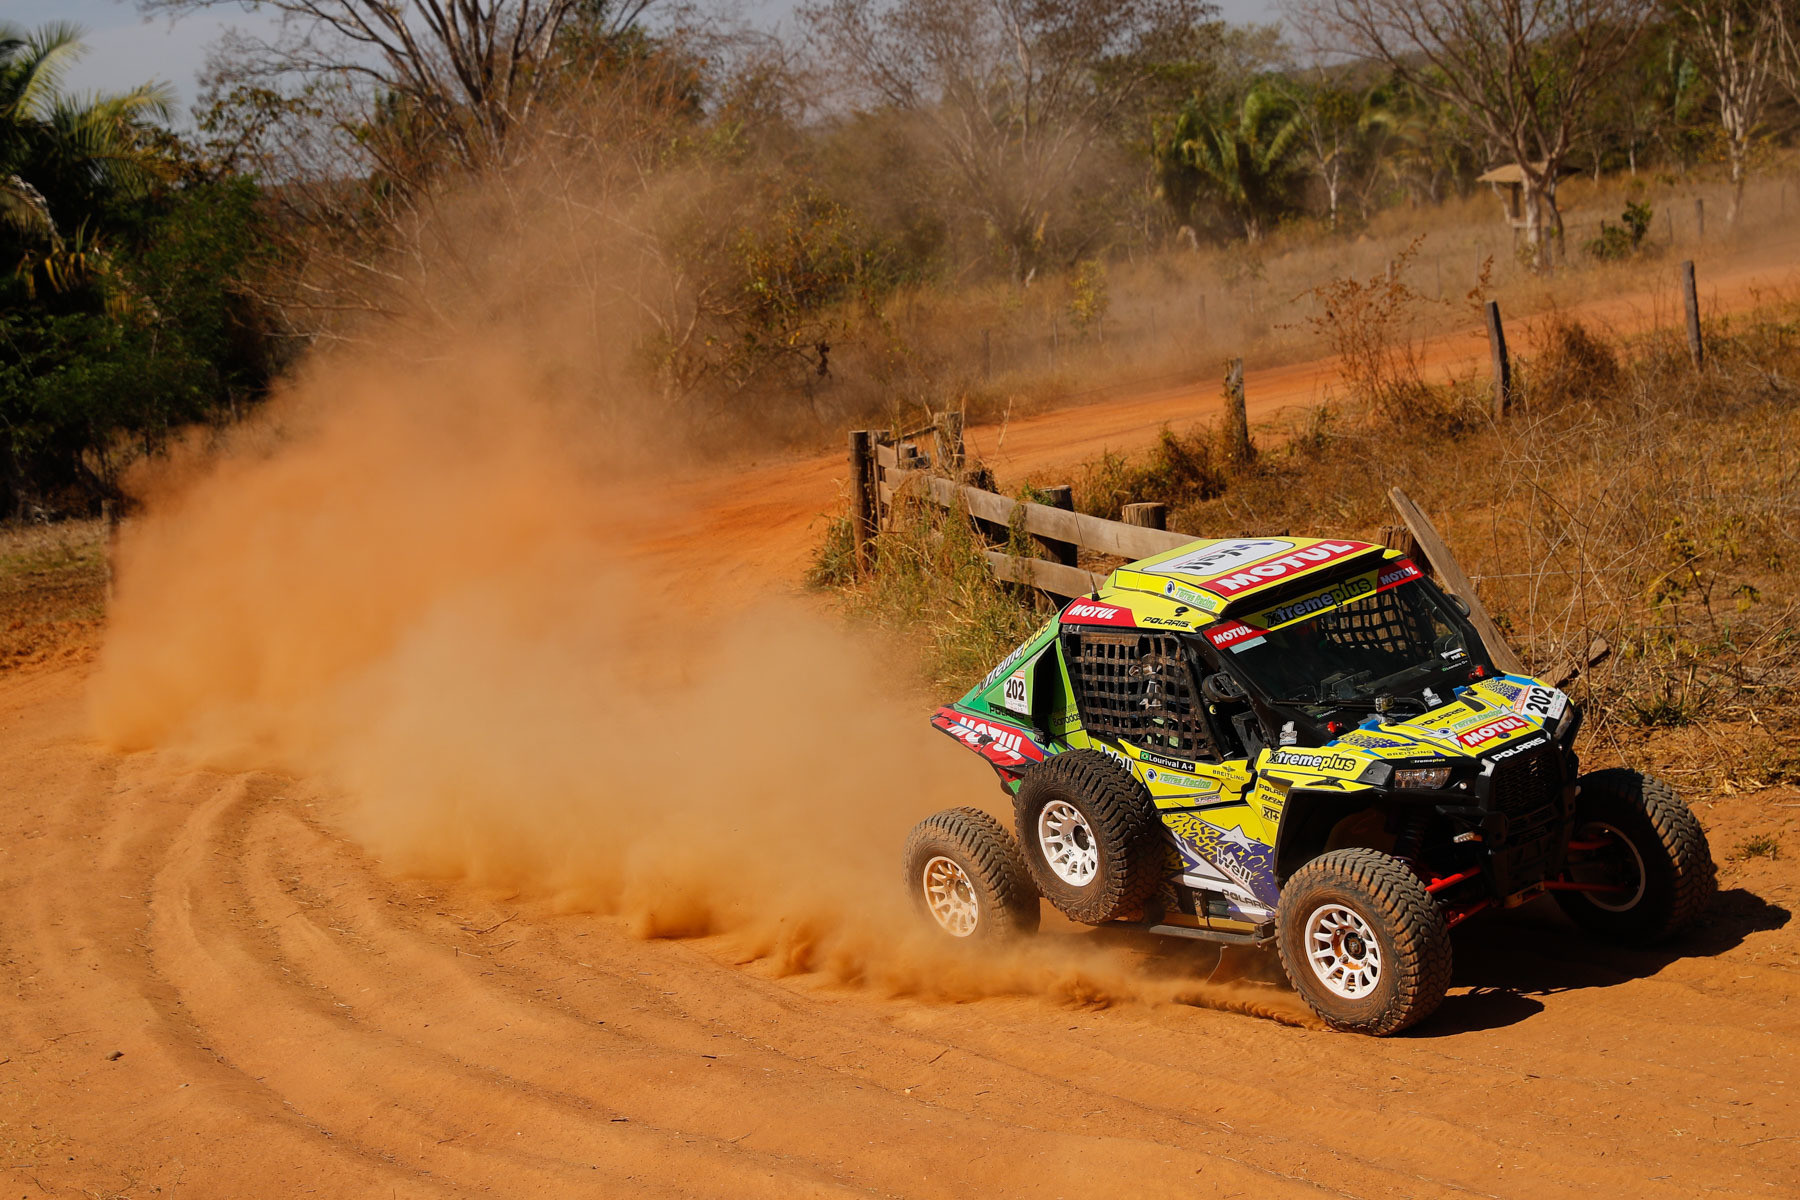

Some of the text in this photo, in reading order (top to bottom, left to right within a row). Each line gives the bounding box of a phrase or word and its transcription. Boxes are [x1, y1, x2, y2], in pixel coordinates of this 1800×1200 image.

[1217, 539, 1356, 591] MOTUL
[1380, 566, 1418, 585] MOTUL
[1067, 604, 1119, 620] MOTUL
[1195, 594, 1218, 611] Racing
[1142, 616, 1192, 628] POLARIS
[1212, 625, 1253, 645] MOTUL
[1006, 678, 1025, 701] 202
[1526, 687, 1555, 715] 202
[1418, 708, 1467, 727] POLARIS
[946, 716, 1023, 760] MOTUL
[1463, 718, 1525, 746] MOTUL
[1386, 749, 1433, 757] BREITLING
[1491, 737, 1546, 762] POLARIS
[1148, 755, 1194, 771] Lourival A+
[1182, 775, 1212, 789] Racing
[1212, 769, 1245, 781] BREITLING
[1216, 846, 1253, 885] Well
[1222, 888, 1274, 912] POLARIS
